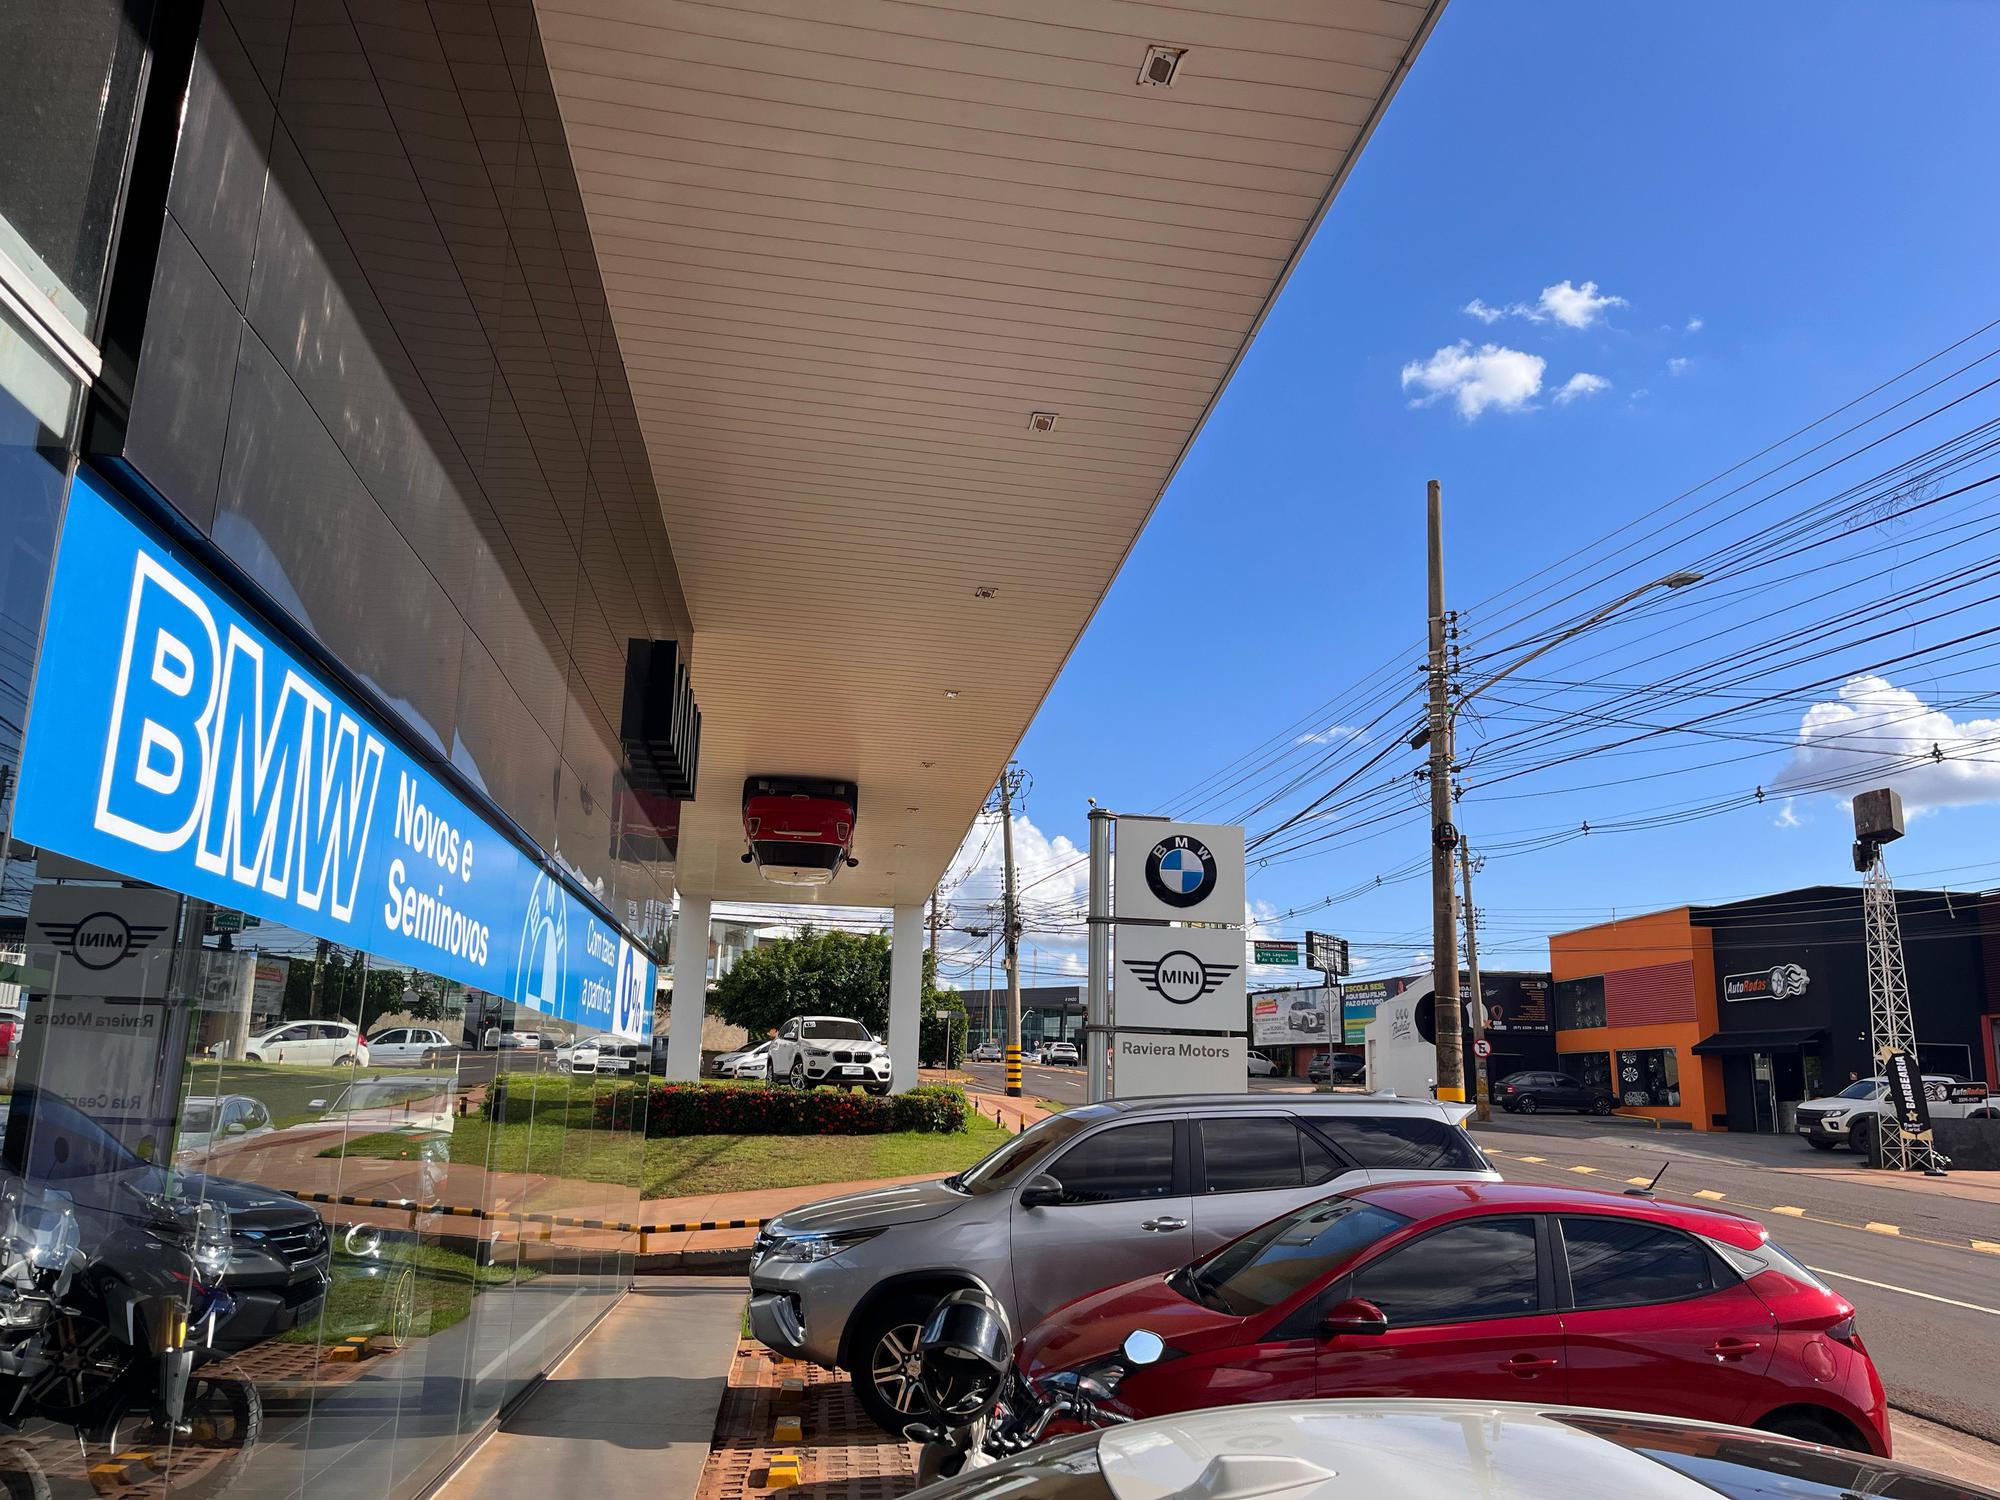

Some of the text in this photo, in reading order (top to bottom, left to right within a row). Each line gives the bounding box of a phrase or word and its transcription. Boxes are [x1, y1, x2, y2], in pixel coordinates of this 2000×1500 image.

[94, 549, 385, 923] BMW
[394, 770, 473, 883] Novos e
[1152, 837, 1212, 861] BMW
[385, 858, 489, 967] Seminovos
[587, 918, 616, 968] Com taxas
[1162, 970, 1199, 985] MINI
[1345, 984, 1369, 992] ESCOLA
[1727, 978, 1767, 994] AutoRodas
[586, 976, 604, 1015] partir
[604, 980, 612, 1014] de
[1370, 990, 1387, 998] FILHO
[1122, 1041, 1230, 1058] Raviera Motors
[1894, 1055, 1916, 1109] BARBEARIA
